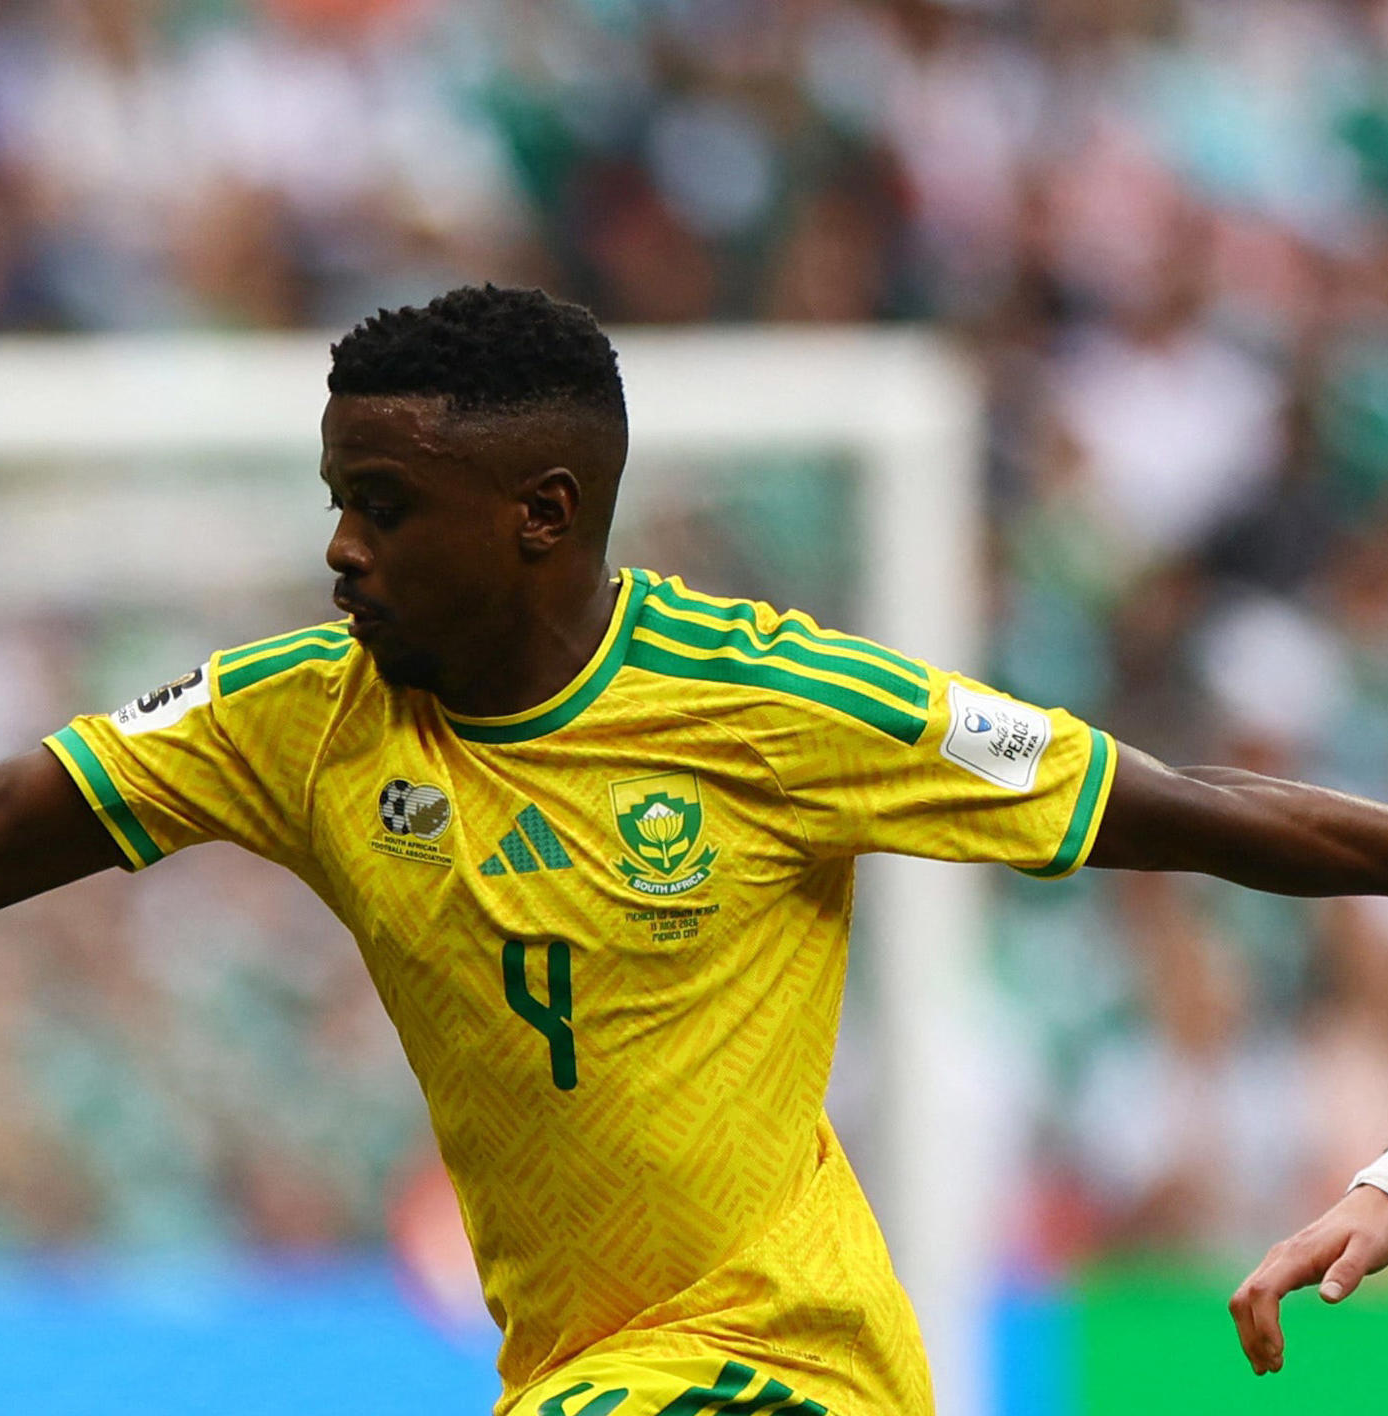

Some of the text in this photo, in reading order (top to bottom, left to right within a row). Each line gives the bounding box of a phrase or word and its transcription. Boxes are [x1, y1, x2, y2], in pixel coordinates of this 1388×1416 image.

[1003, 717, 1029, 761] PEACE
[1022, 735, 1038, 758] FIFA
[633, 871, 705, 894] SOUTH AFRICA
[501, 940, 578, 1090] 4
